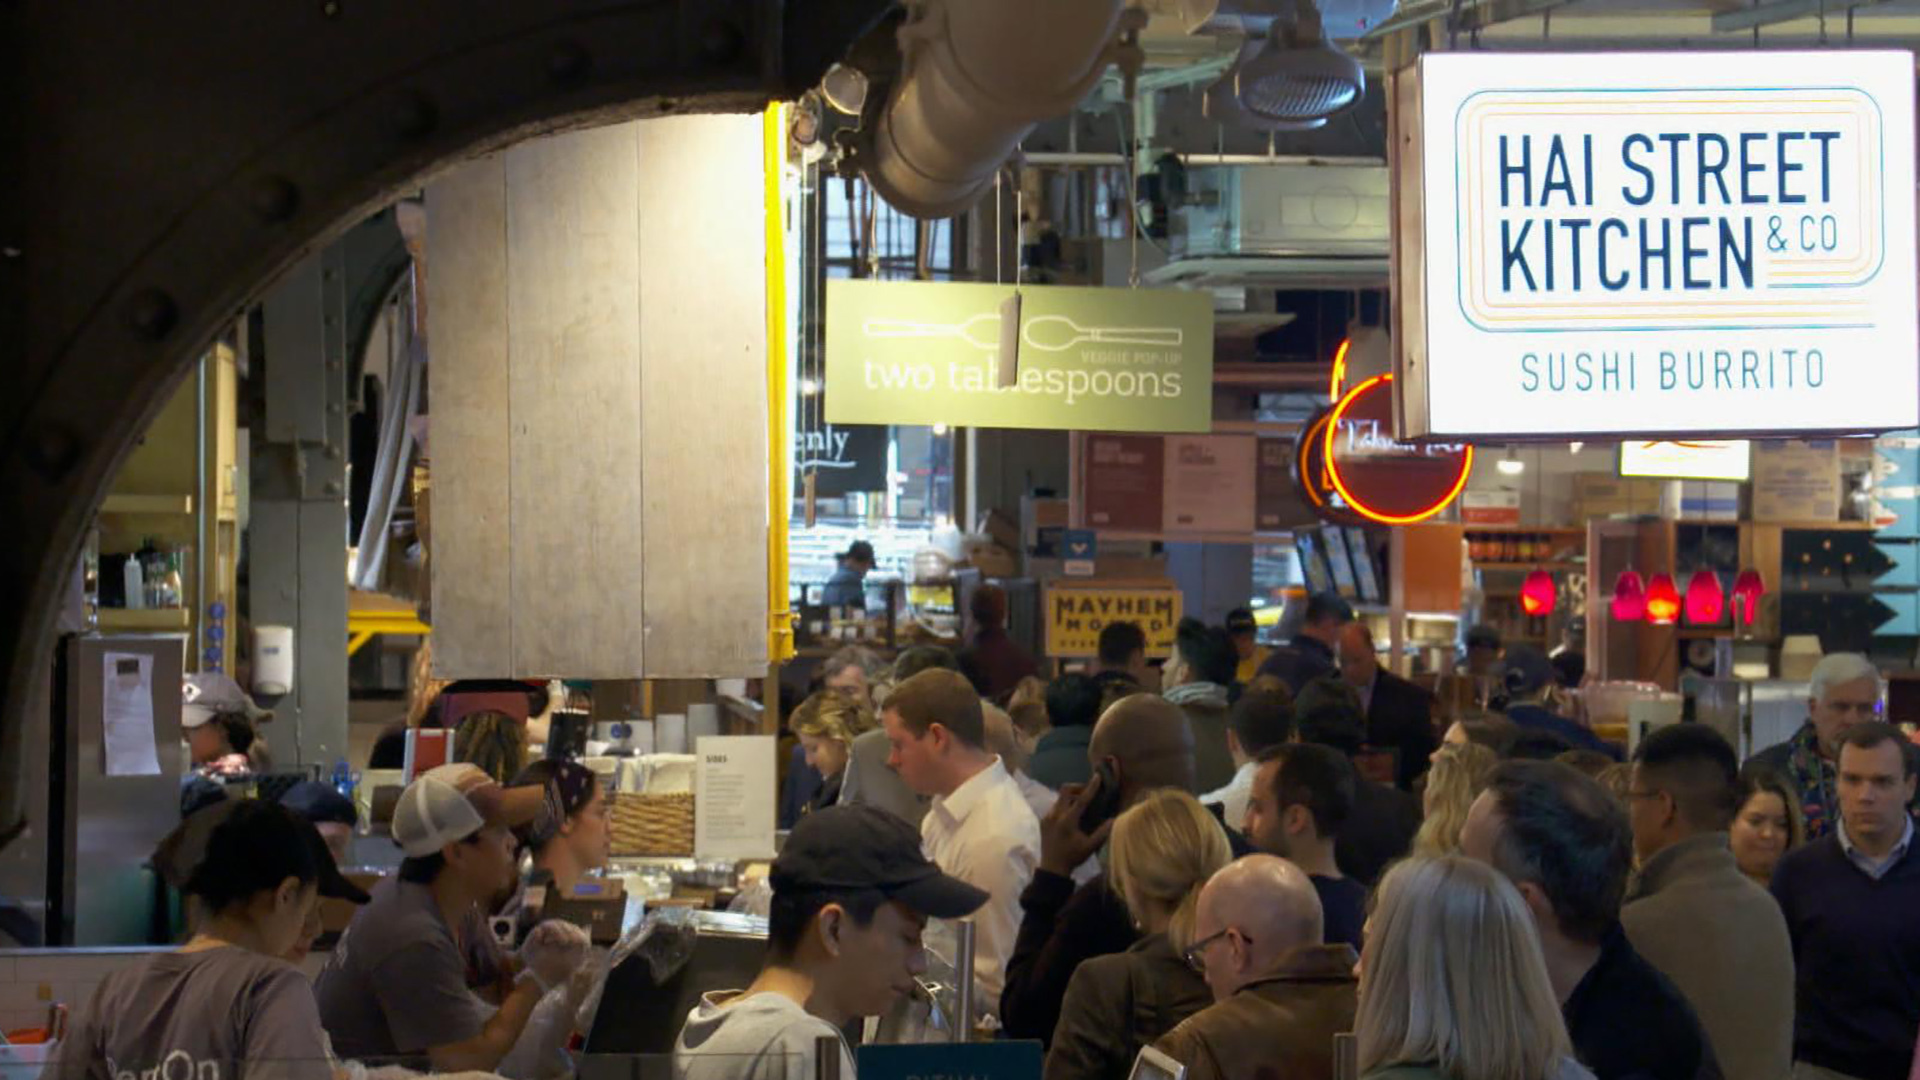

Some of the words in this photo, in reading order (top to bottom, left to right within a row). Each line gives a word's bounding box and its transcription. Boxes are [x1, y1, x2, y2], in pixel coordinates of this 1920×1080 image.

[1499, 133, 1594, 207] HAI
[1621, 131, 1841, 206] STREET
[1500, 216, 1755, 292] KITCHEN
[1766, 216, 1788, 251] &
[1800, 214, 1838, 251] CO
[863, 360, 936, 391] two
[949, 355, 1183, 404] tabespoons
[1521, 352, 1637, 392] SUSHI
[1660, 349, 1824, 391] BURRITO
[1056, 597, 1173, 626] MAYHEM
[1066, 618, 1163, 632] MOD
